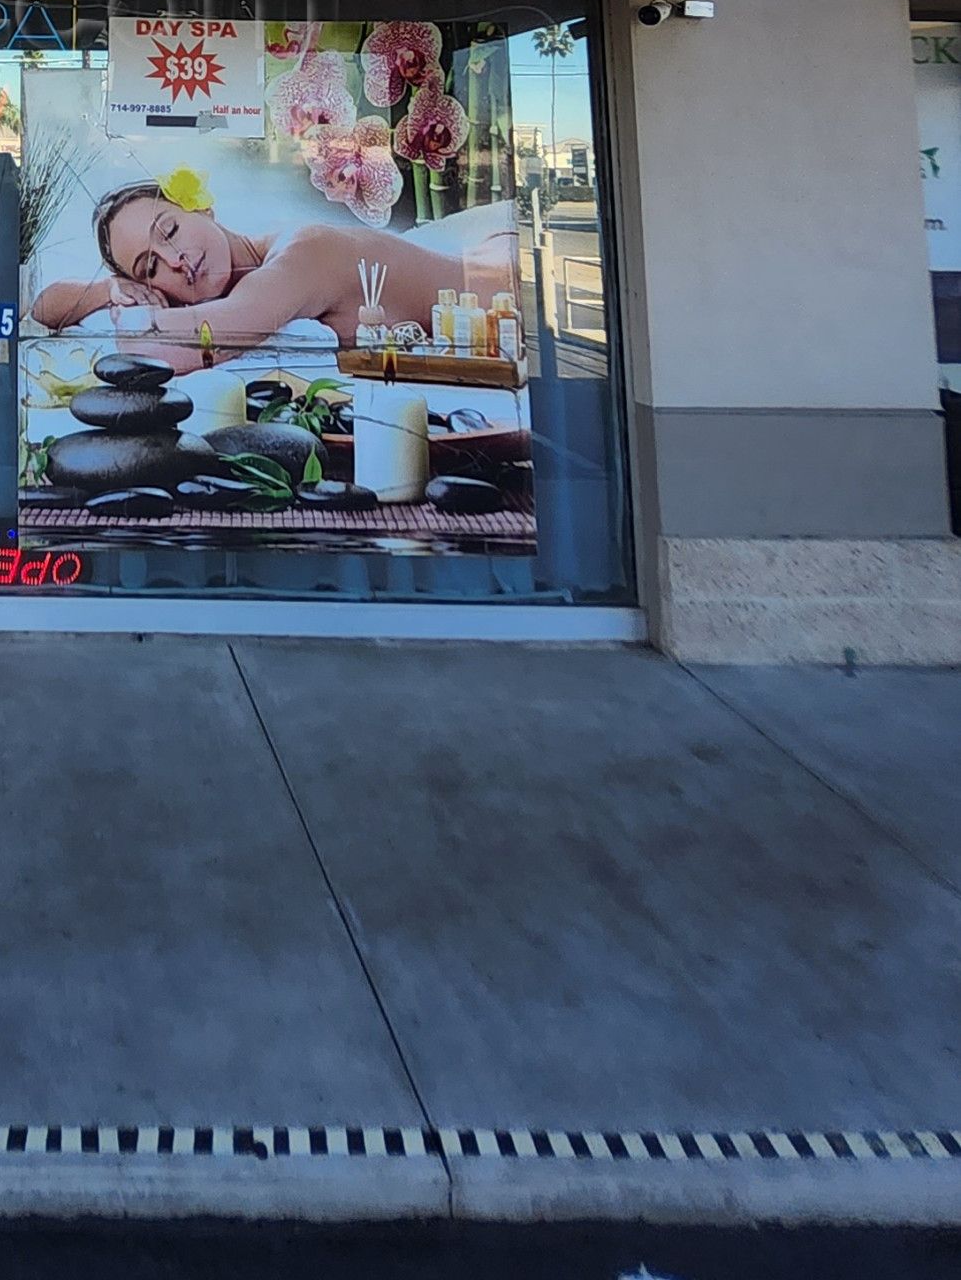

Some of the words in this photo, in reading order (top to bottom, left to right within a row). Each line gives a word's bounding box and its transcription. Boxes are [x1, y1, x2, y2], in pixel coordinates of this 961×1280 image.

[136, 20, 183, 37] DAY
[190, 21, 237, 38] SPA
[165, 56, 208, 81] $39
[110, 104, 172, 113] 714-997-8885
[213, 105, 229, 114] Half
[231, 107, 241, 115] an
[243, 107, 261, 115] hour
